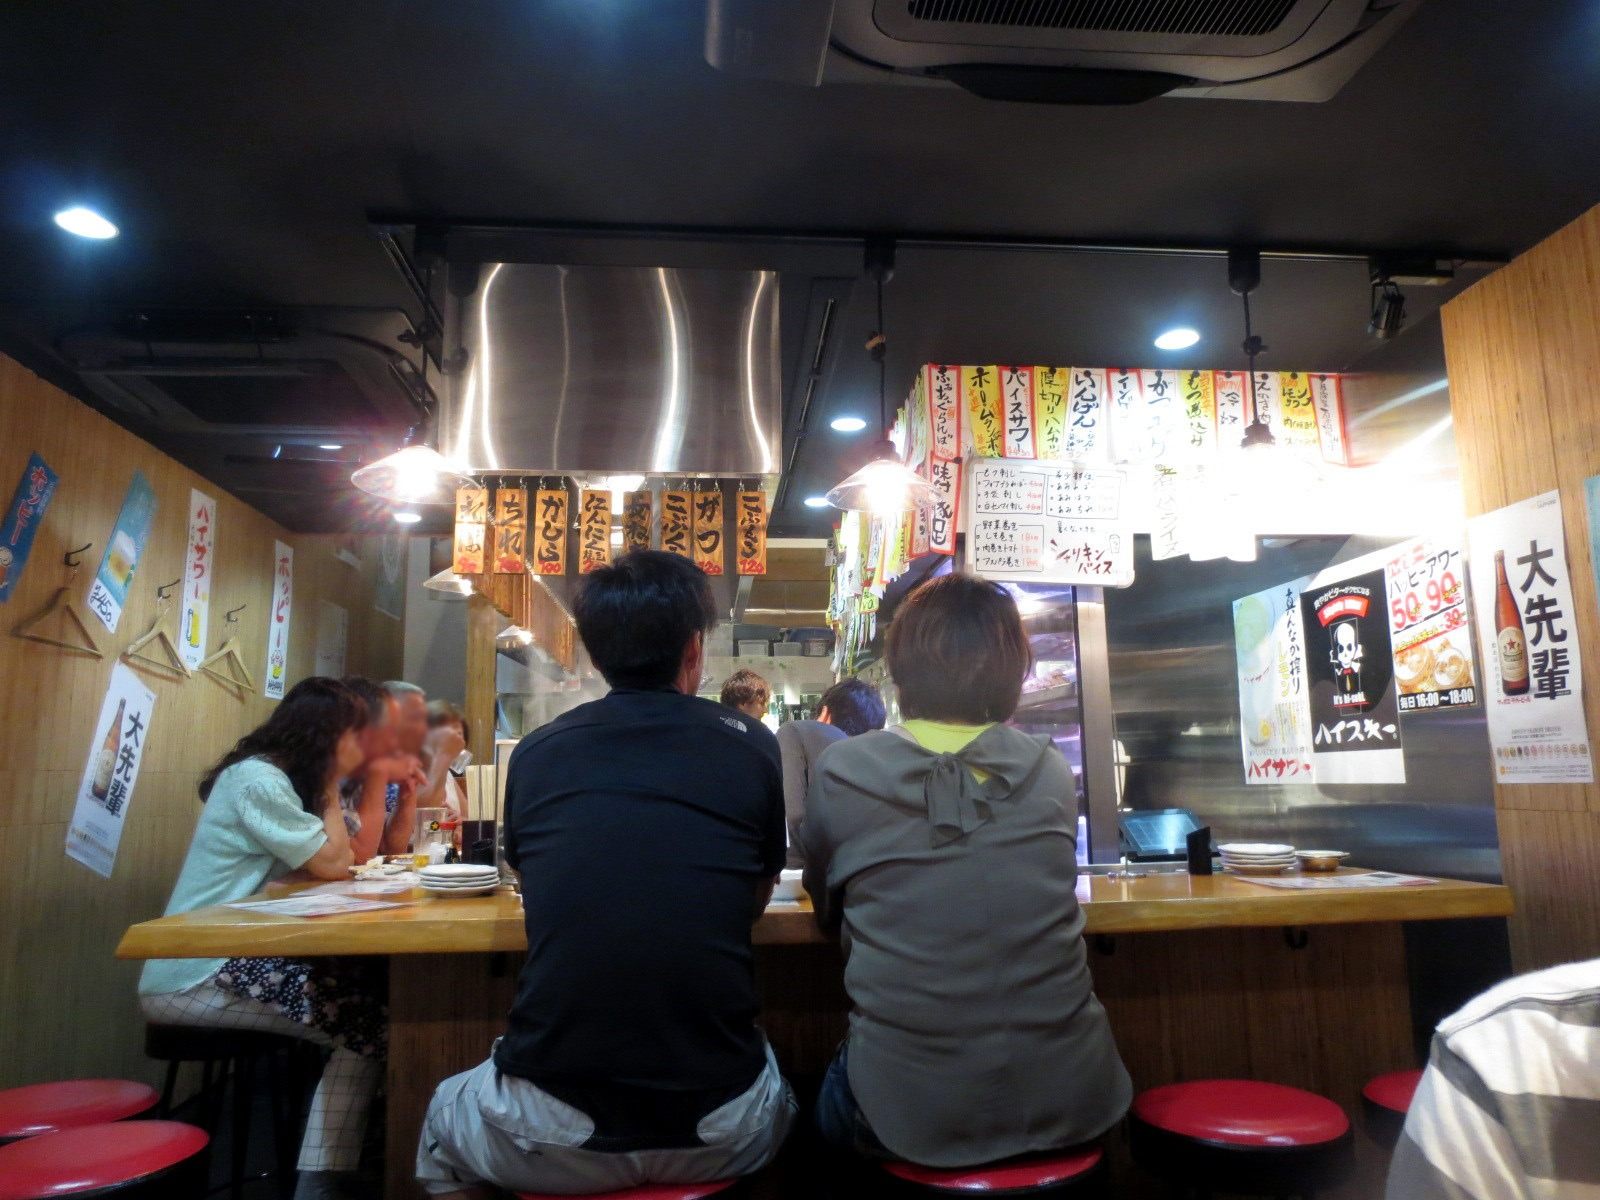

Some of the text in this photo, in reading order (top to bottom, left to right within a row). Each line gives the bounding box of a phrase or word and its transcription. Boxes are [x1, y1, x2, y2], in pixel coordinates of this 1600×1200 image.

[1072, 372, 1099, 427] いんげん
[537, 495, 564, 562] かしら
[1078, 561, 1112, 574] バイス
[1390, 550, 1459, 598] ハッピーアワー
[1517, 539, 1570, 701] 大先輩
[1315, 718, 1396, 745] ハイスキー
[105, 711, 144, 818] 大先輩
